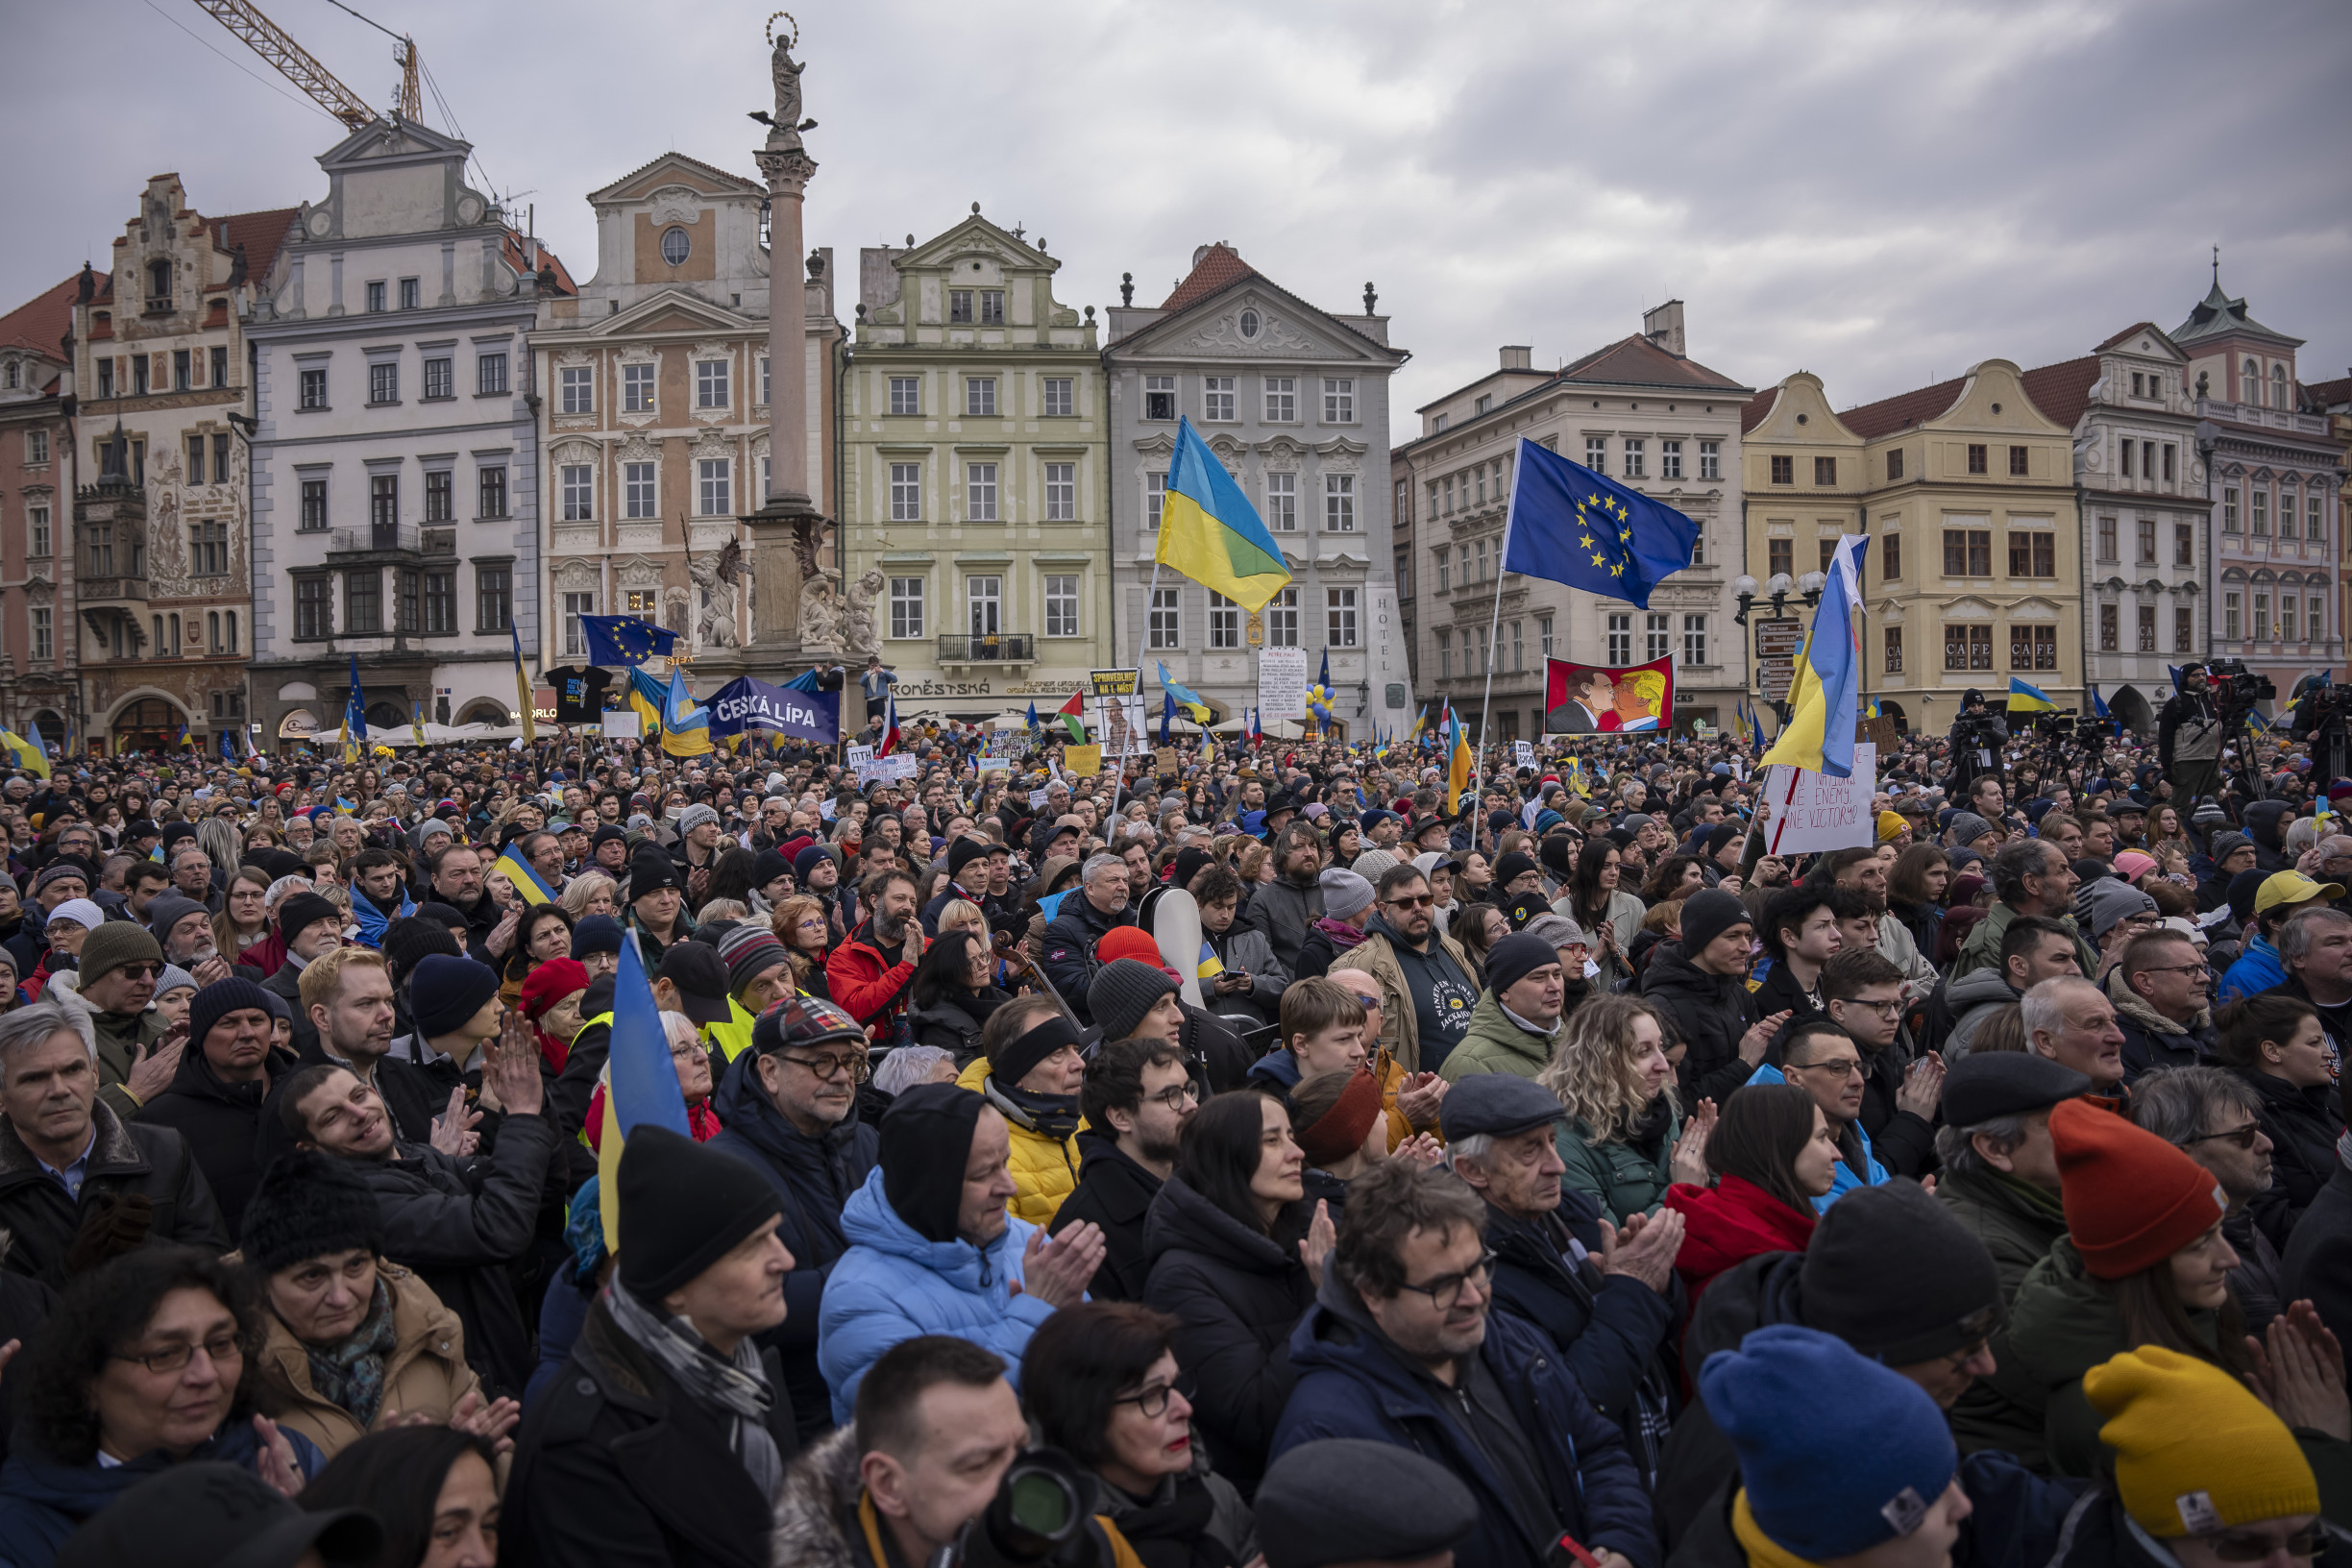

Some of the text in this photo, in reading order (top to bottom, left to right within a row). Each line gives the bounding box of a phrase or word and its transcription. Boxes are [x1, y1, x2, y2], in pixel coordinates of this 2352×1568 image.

[1378, 599, 1389, 671] HOTEL
[2140, 625, 2153, 637] CA
[1946, 643, 1990, 655] CAFE
[2011, 643, 2054, 655] CAFE
[2141, 639, 2153, 650] FE
[1887, 646, 1901, 657] CA
[1888, 658, 1901, 671] FE
[1093, 673, 1137, 682] SPRAVEDLNOS
[891, 677, 990, 696] ROMĚSTSKÁ
[1100, 685, 1109, 694] NA
[1675, 694, 1694, 702] CKS
[531, 708, 557, 718] RLO
[717, 696, 771, 722] ČESKÁ
[775, 703, 816, 727] LÍPA
[992, 730, 1009, 739] FROM
[1000, 737, 1030, 746] PALESTINE
[1876, 733, 1896, 751] LER
[992, 744, 1021, 753] OCCUPATION
[997, 749, 1023, 758] CRIME
[850, 750, 871, 762] ПТН
[894, 754, 912, 765] STOP
[1816, 788, 1852, 805] ENEMY,
